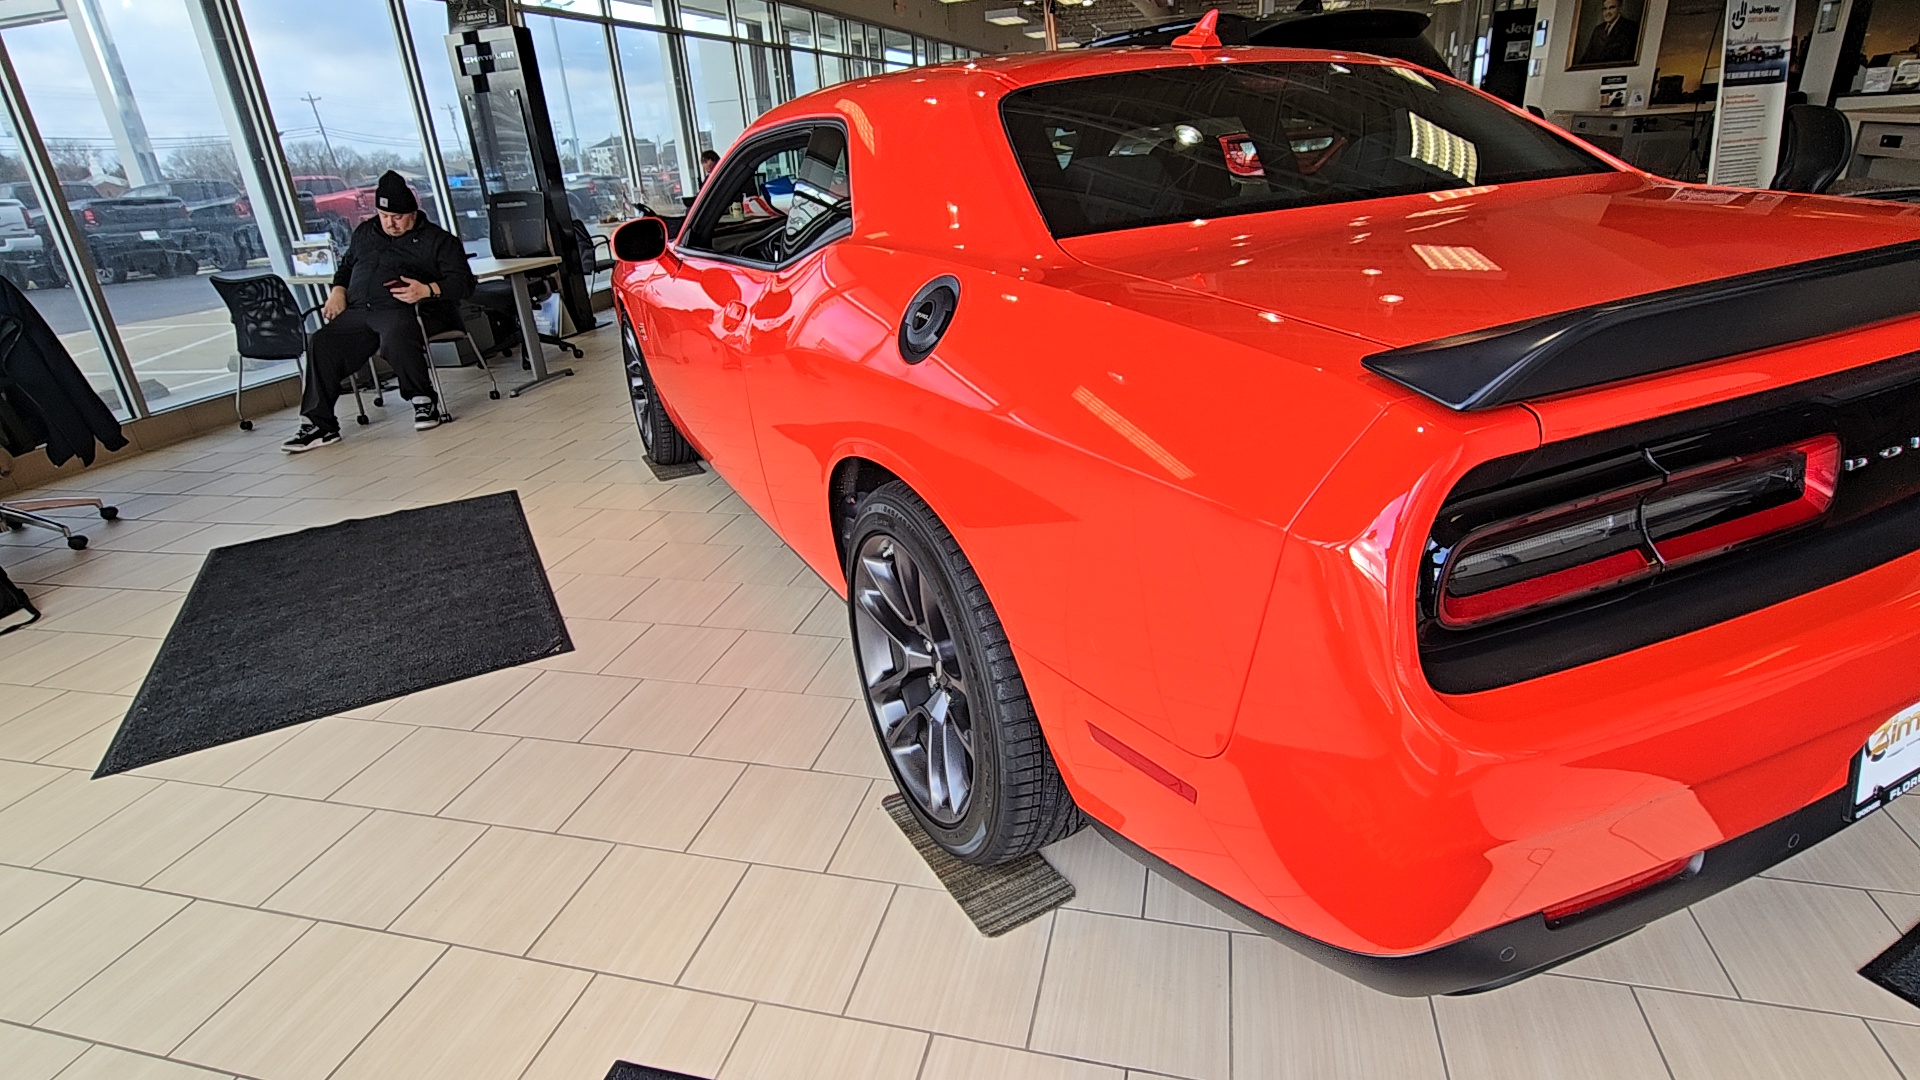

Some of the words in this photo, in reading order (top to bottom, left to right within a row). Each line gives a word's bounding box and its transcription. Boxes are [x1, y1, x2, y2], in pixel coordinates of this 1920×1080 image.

[1749, 6, 1764, 16] Jeep
[1764, 5, 1780, 13] Wave
[463, 51, 515, 64] CHRYSLER
